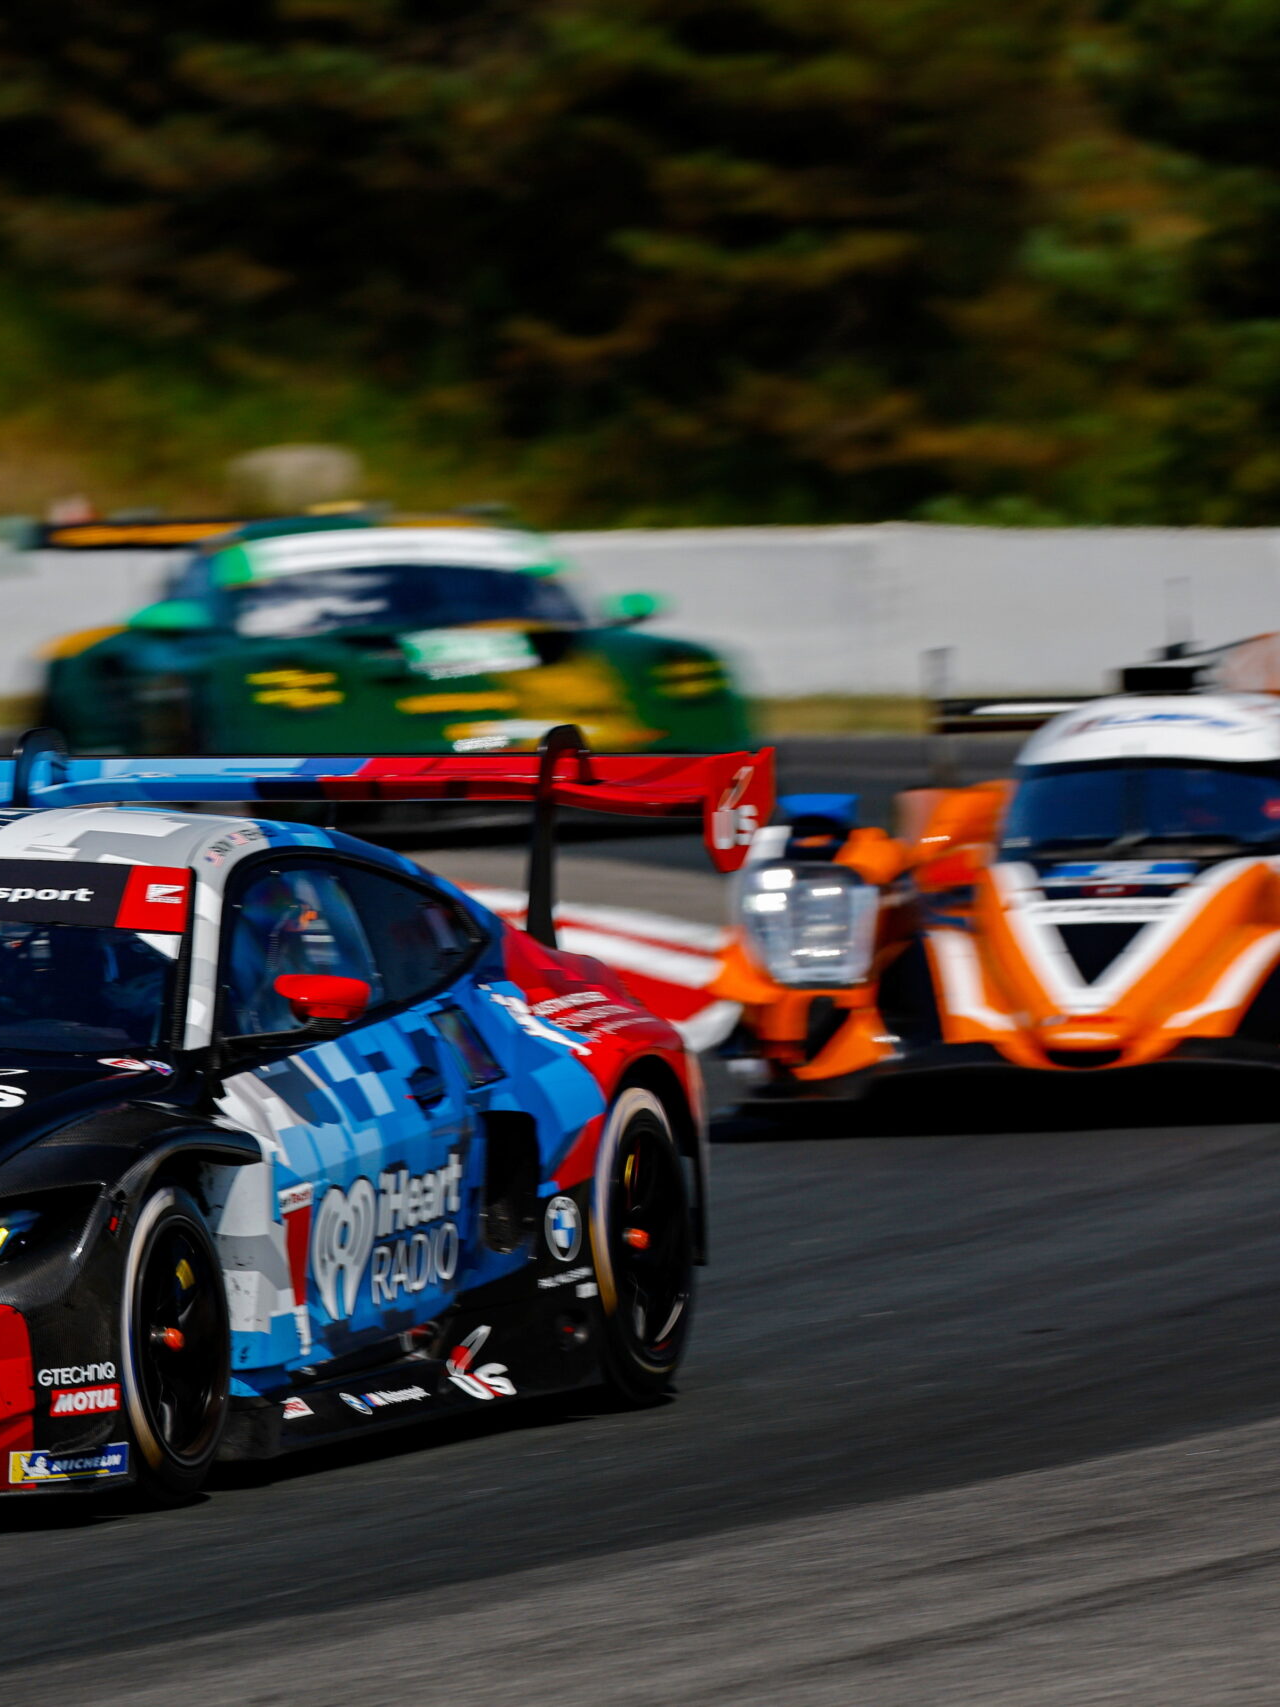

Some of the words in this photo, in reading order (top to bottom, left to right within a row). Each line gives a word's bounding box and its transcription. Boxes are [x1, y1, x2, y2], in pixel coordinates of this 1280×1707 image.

[379, 1152, 462, 1238] iHeart
[372, 1221, 459, 1305] RADIO
[37, 1362, 116, 1386] GTECHNIQ
[53, 1388, 118, 1413] MOTUL
[51, 1454, 122, 1472] MICHELIN
